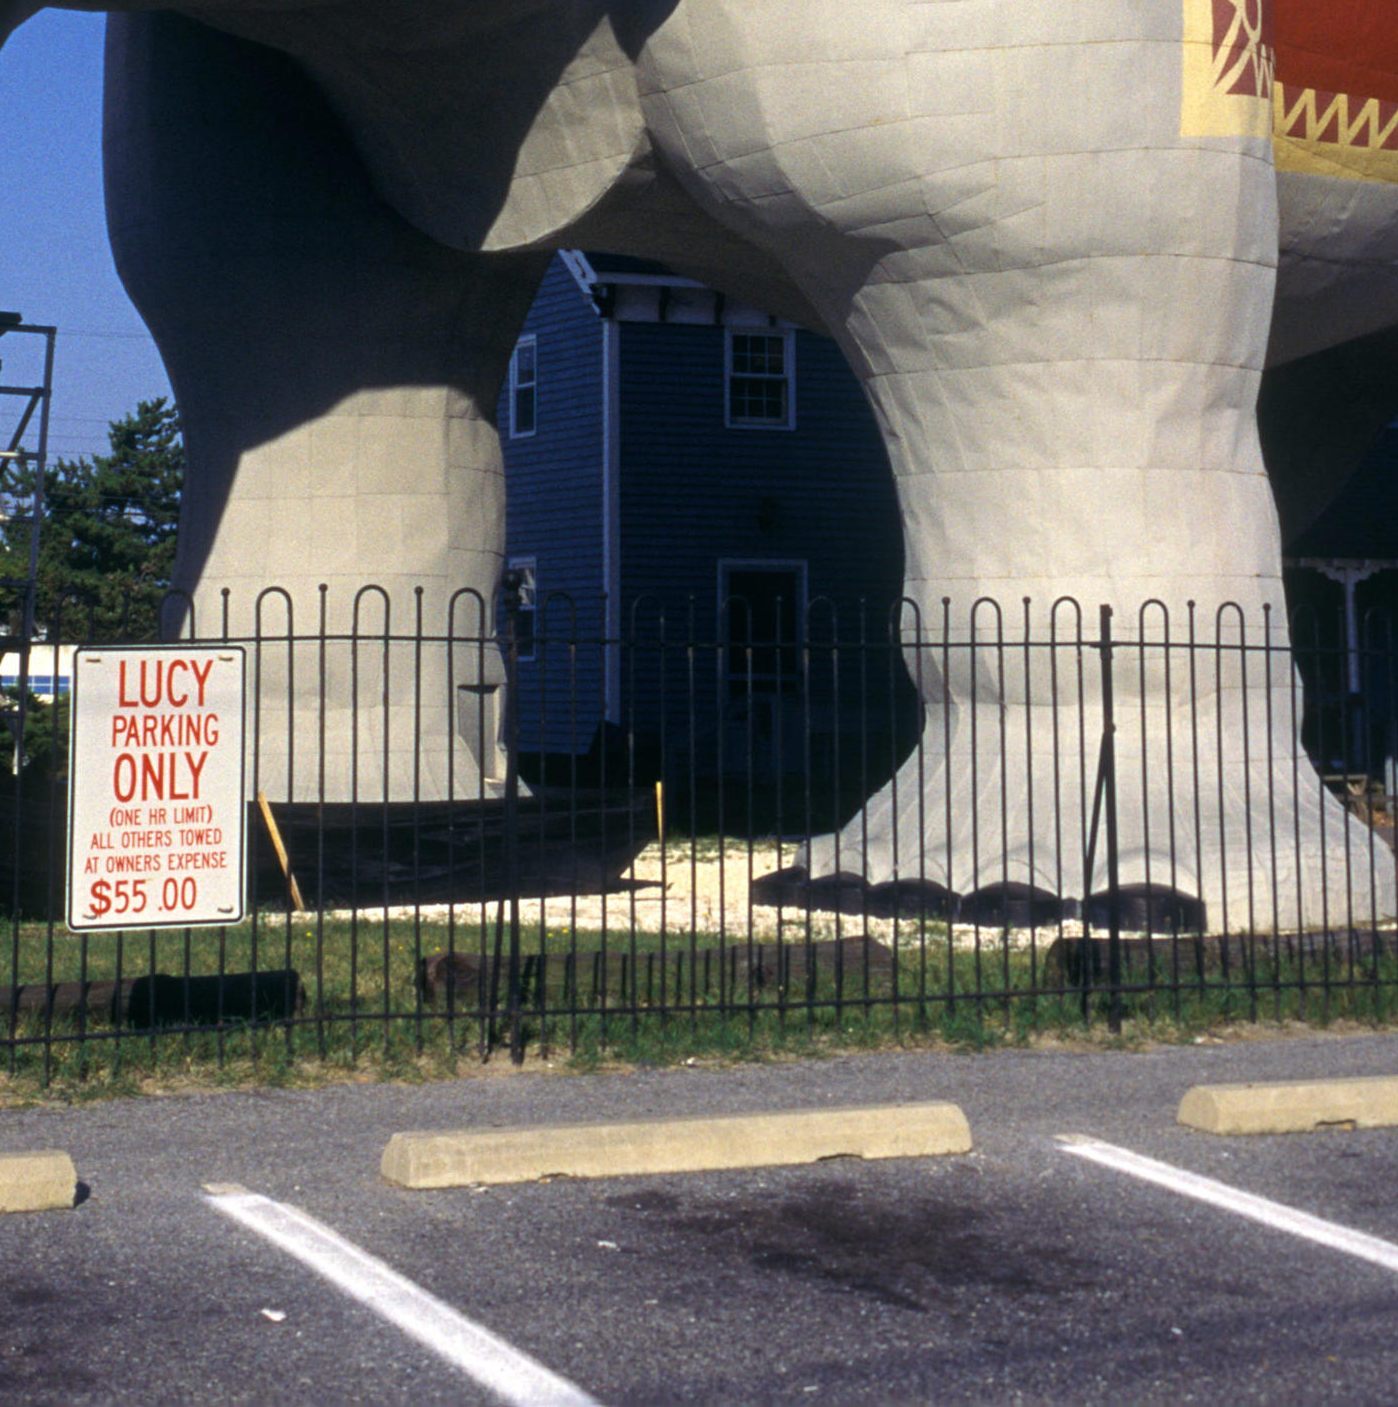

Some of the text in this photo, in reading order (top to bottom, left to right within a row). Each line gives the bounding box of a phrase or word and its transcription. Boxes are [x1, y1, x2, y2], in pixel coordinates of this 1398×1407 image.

[119, 659, 213, 708] LUCY
[112, 714, 219, 748] PARKING
[113, 751, 208, 803] ONLY
[109, 805, 212, 827] (ONE HR LIMIT)
[91, 828, 222, 849] ALL OTHERS TOWED
[84, 851, 227, 874] AT OWNERS EXPENSE
